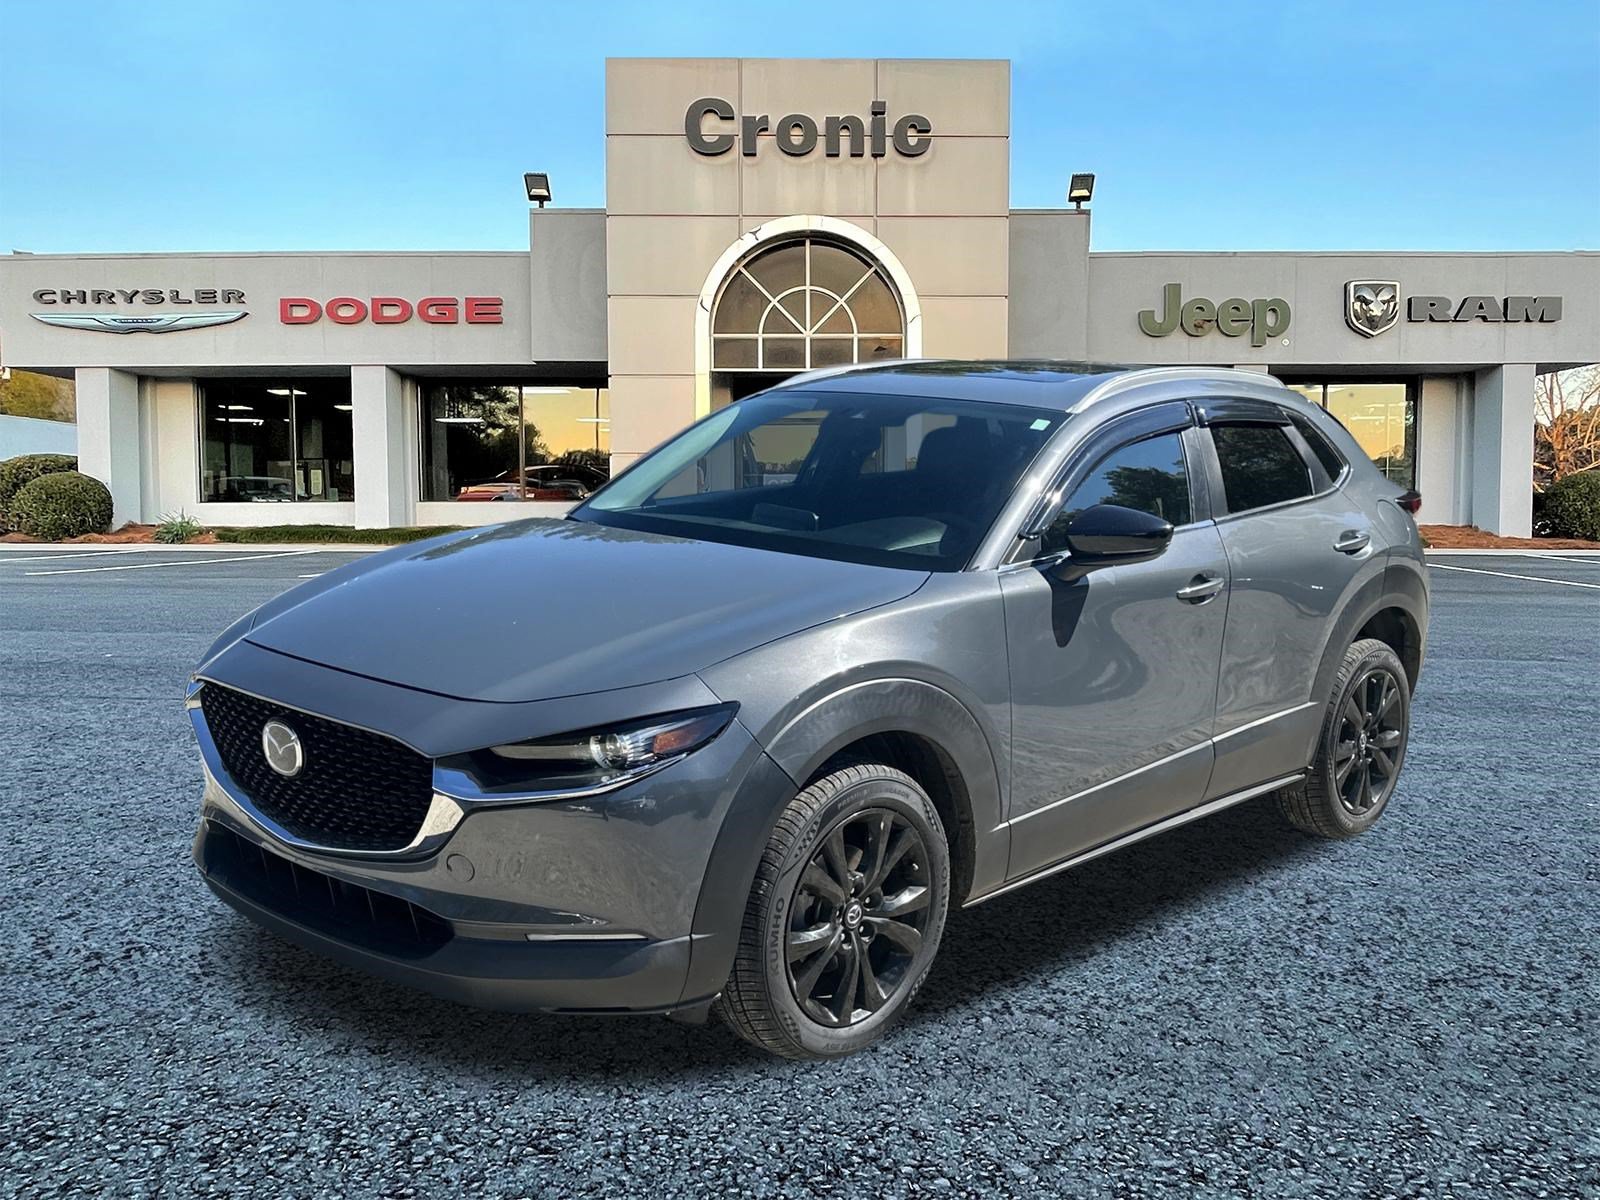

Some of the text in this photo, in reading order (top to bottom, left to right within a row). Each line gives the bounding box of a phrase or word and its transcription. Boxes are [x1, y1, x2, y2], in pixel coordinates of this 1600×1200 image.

[685, 97, 932, 157] Cronic
[32, 289, 247, 304] CHRYSLER
[279, 297, 504, 324] DODGE
[1138, 283, 1291, 348] Jeep
[1407, 296, 1562, 322] RAM
[770, 897, 785, 976] KUMHO
